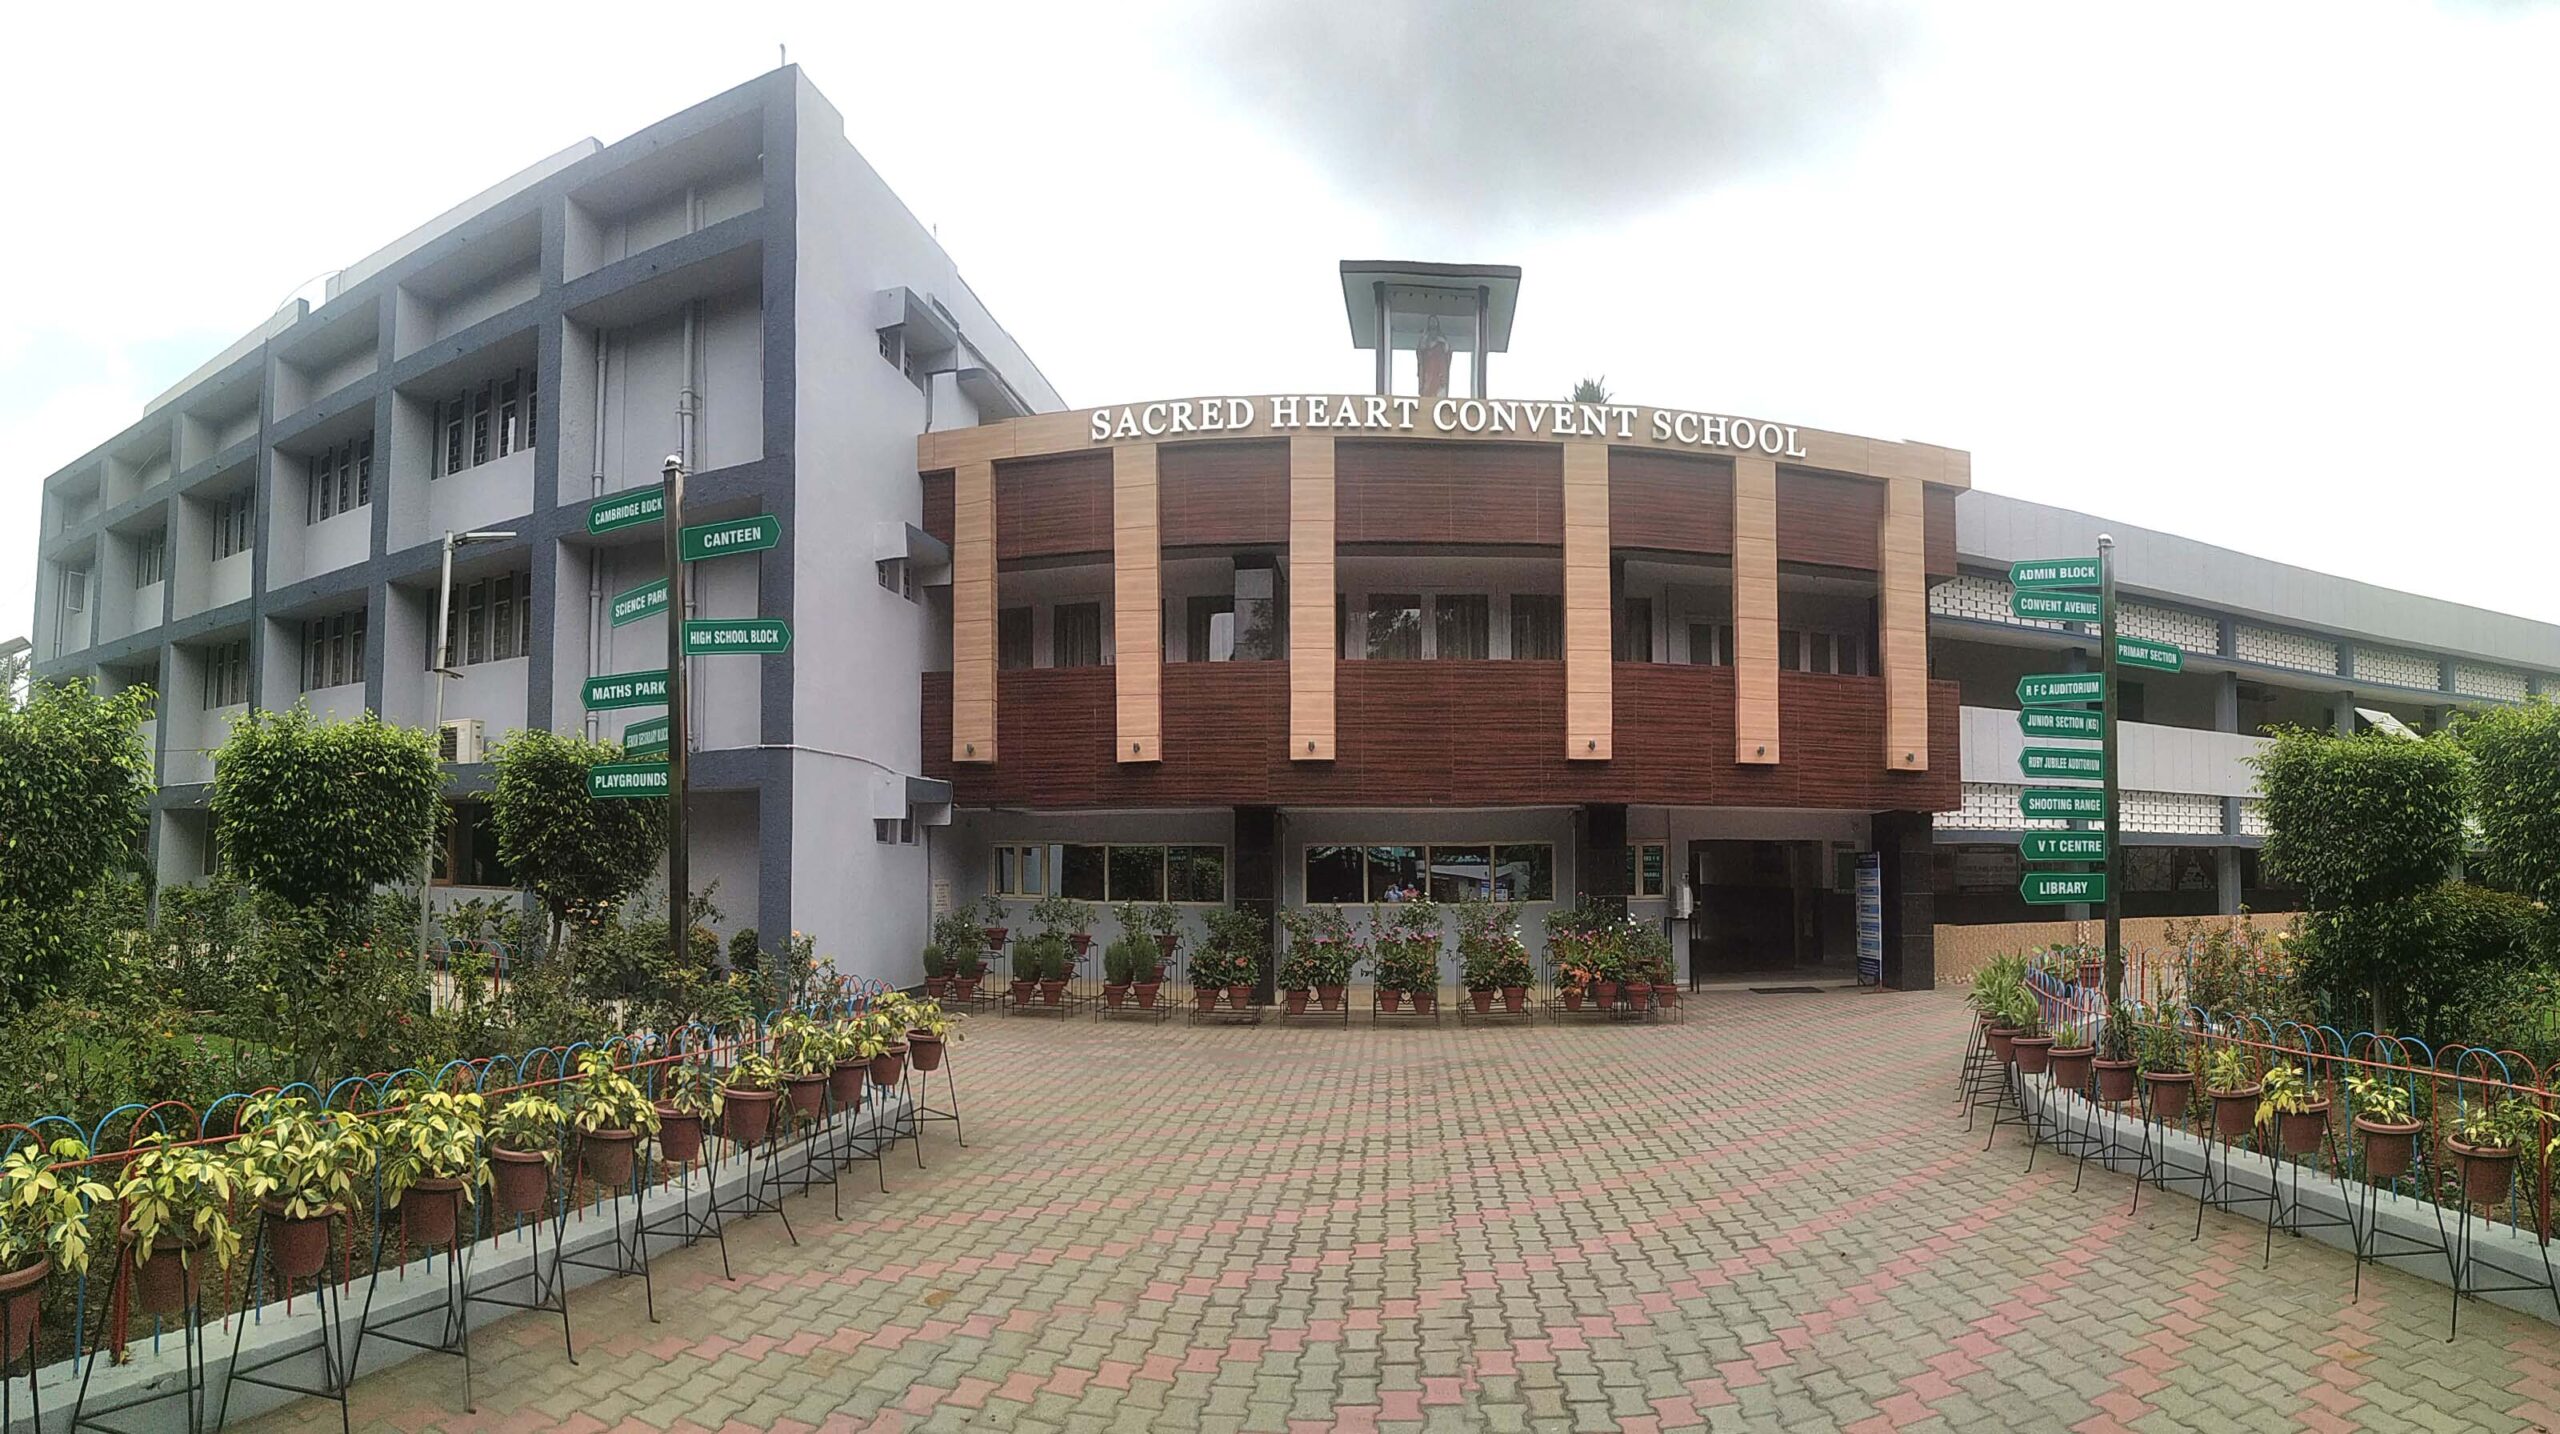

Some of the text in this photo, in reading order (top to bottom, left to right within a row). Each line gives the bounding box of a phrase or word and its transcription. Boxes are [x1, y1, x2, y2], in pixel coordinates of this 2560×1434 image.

[1091, 396, 1807, 458] SACRED HEART CONVENT SCHOOL
[595, 502, 640, 525] CAMBRIDGE
[703, 526, 762, 548] CANTEEN
[2019, 566, 2096, 581] ADMIN BLOCK
[615, 587, 668, 618] SCIENCE PARK
[2021, 598, 2098, 615] CONVENT AVENUE
[690, 629, 779, 645] HIGH SCHOOL BLOCK
[2118, 644, 2177, 664] PRIMARY SECTION
[592, 681, 666, 701] MATHS PARK
[2026, 682, 2099, 696] R F C AUDITORIUM
[2027, 714, 2100, 733] JUNIOR SECTION (KG)
[2044, 757, 2067, 769] JUBILEE
[2068, 758, 2100, 771] AUDITORIUM
[595, 772, 668, 788] PLAYGROUNDS
[2029, 798, 2101, 811] SHOOTING RANGE
[2038, 840, 2102, 852] V T CENTRE
[2039, 881, 2088, 895] LIBRARY
